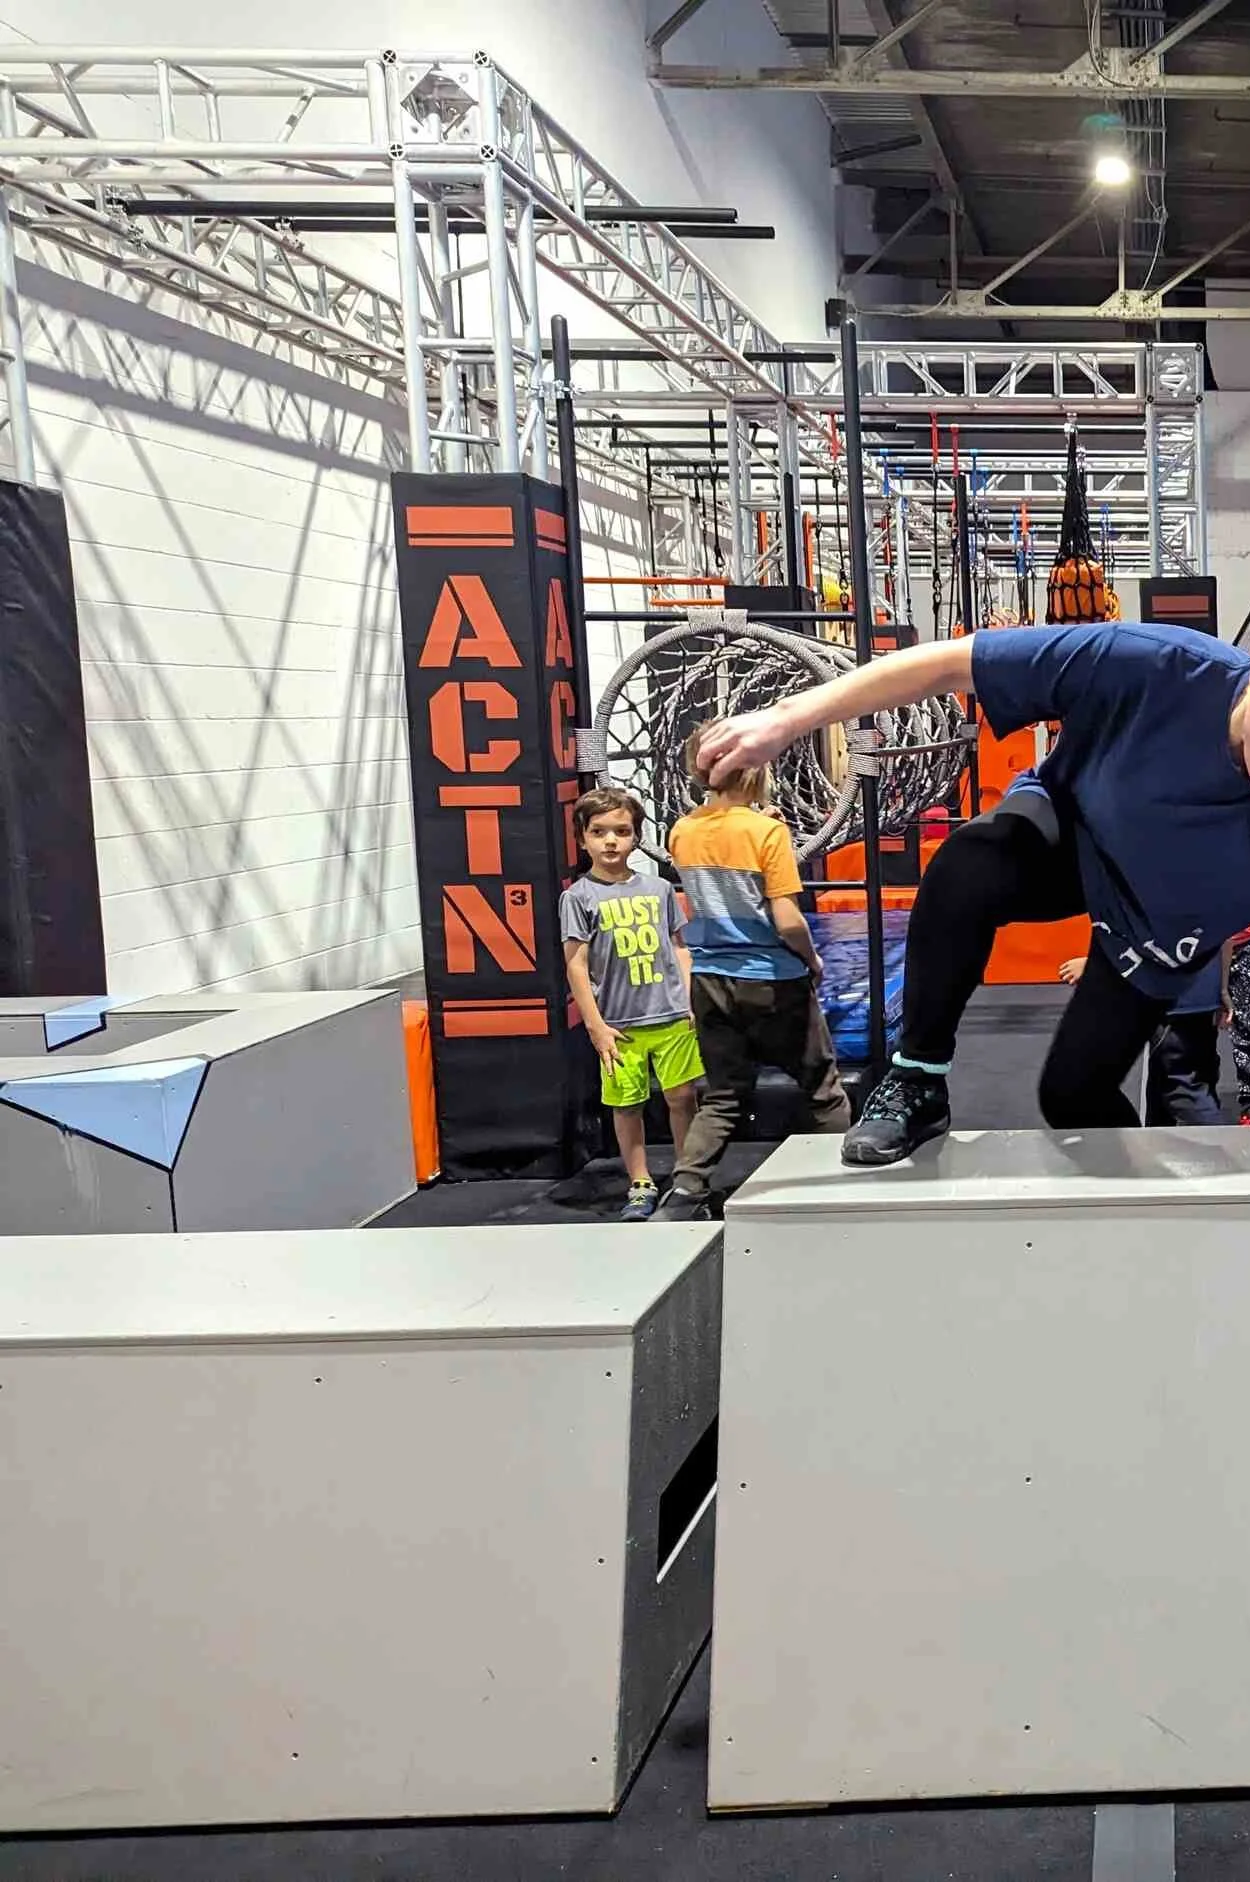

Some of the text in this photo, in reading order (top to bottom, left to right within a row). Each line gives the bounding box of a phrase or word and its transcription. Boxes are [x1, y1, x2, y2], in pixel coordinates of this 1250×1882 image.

[545, 577, 580, 890] ACT
[418, 575, 536, 973] ACTN 3
[599, 895, 660, 932] JUST
[614, 924, 660, 958] DO
[628, 954, 664, 986] IT.
